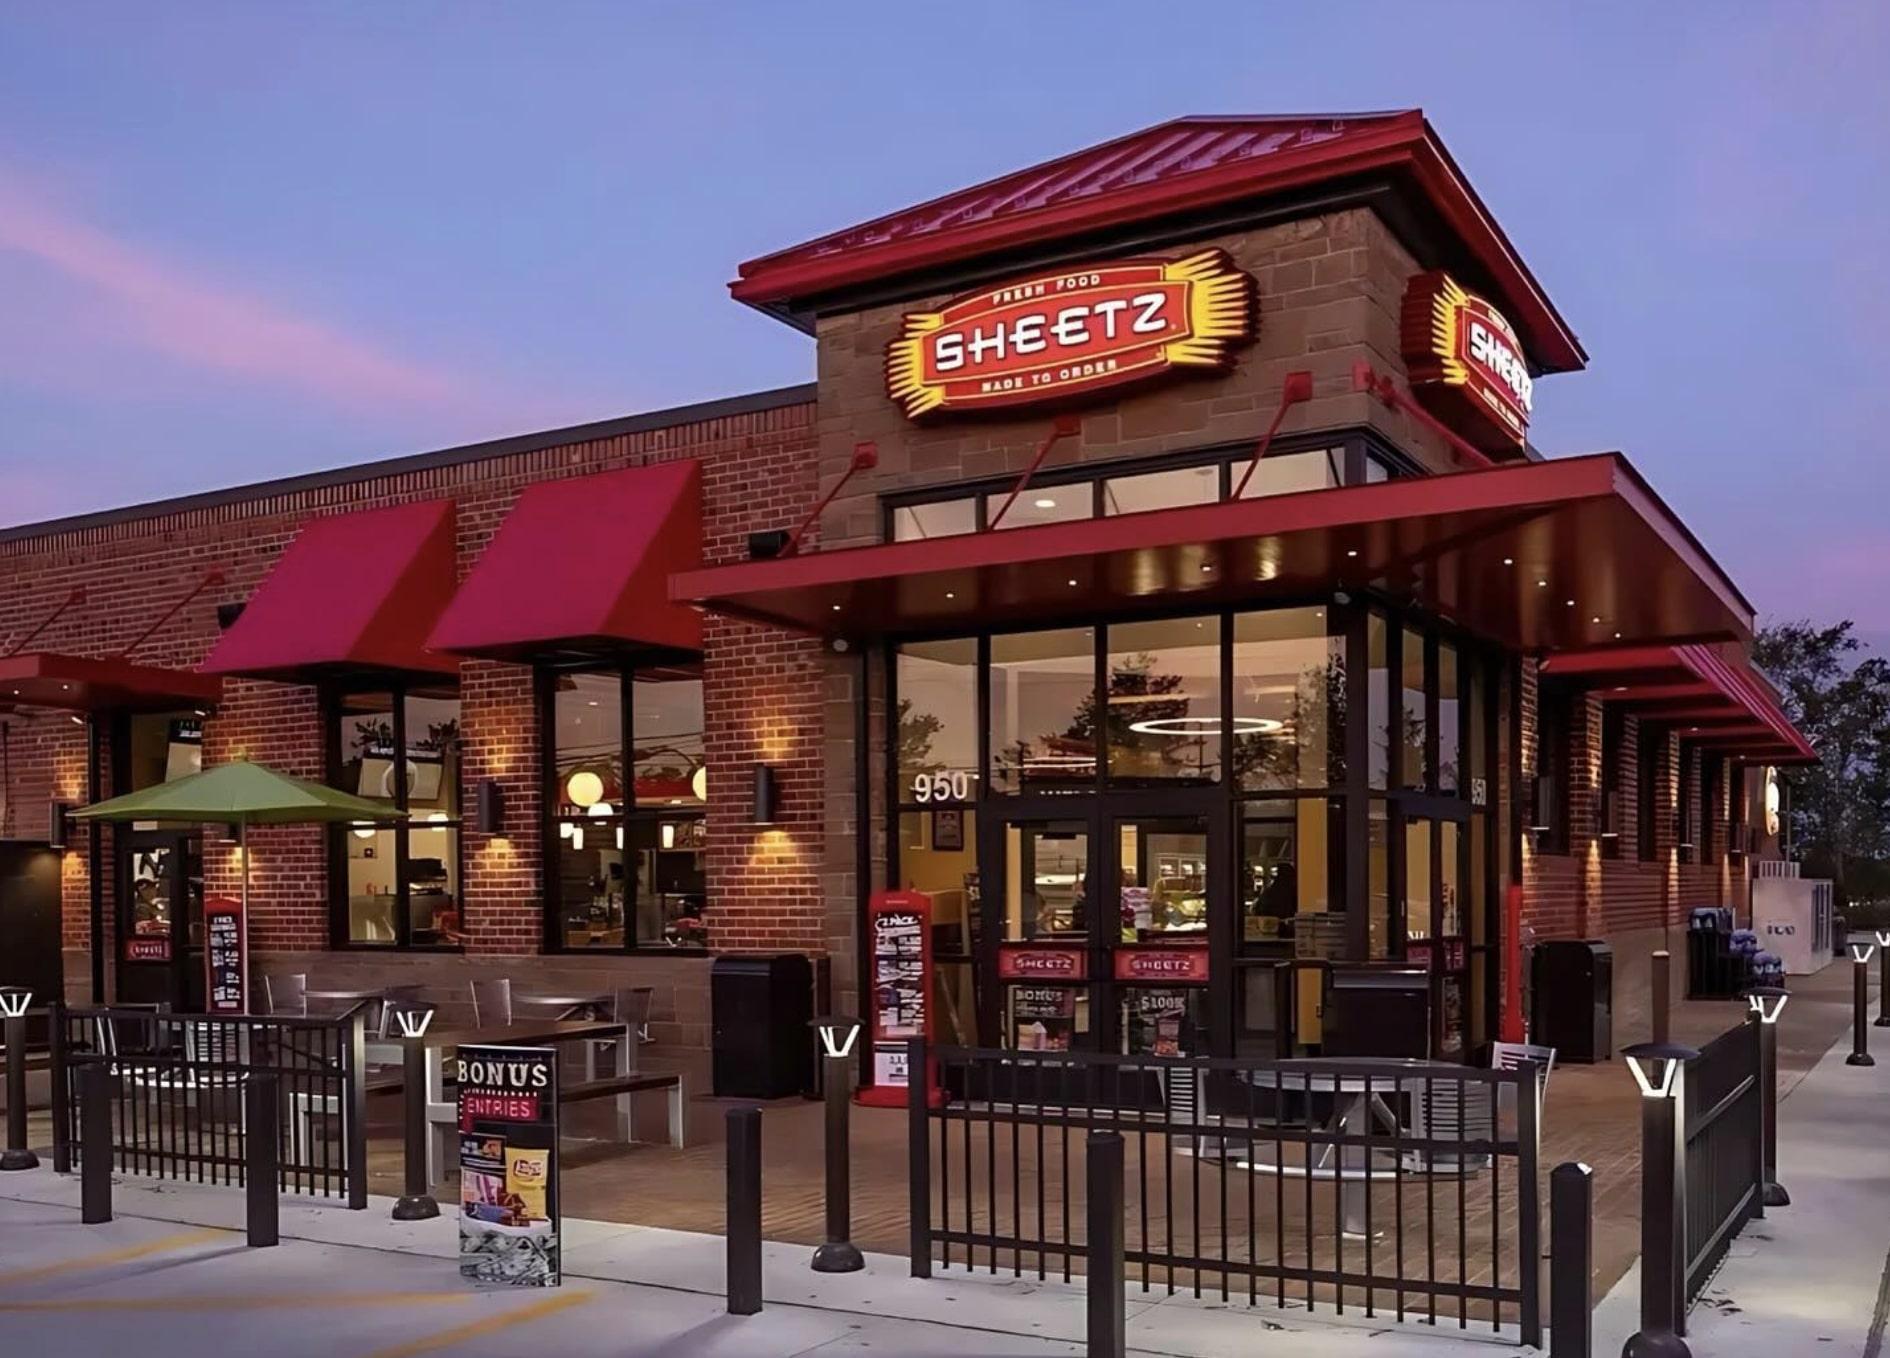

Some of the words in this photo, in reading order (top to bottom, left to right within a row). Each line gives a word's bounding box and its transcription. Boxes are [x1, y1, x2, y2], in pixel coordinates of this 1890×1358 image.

[993, 284, 1045, 305] FRESH
[1056, 274, 1100, 291] FOOD
[935, 292, 1167, 371] SHEETZ
[982, 377, 1024, 392] MADE
[1032, 372, 1051, 385] TO
[1060, 359, 1117, 380] ORDER
[914, 771, 968, 802] 950
[457, 1060, 547, 1087] BONUS
[467, 1098, 531, 1117] ENTRIES
